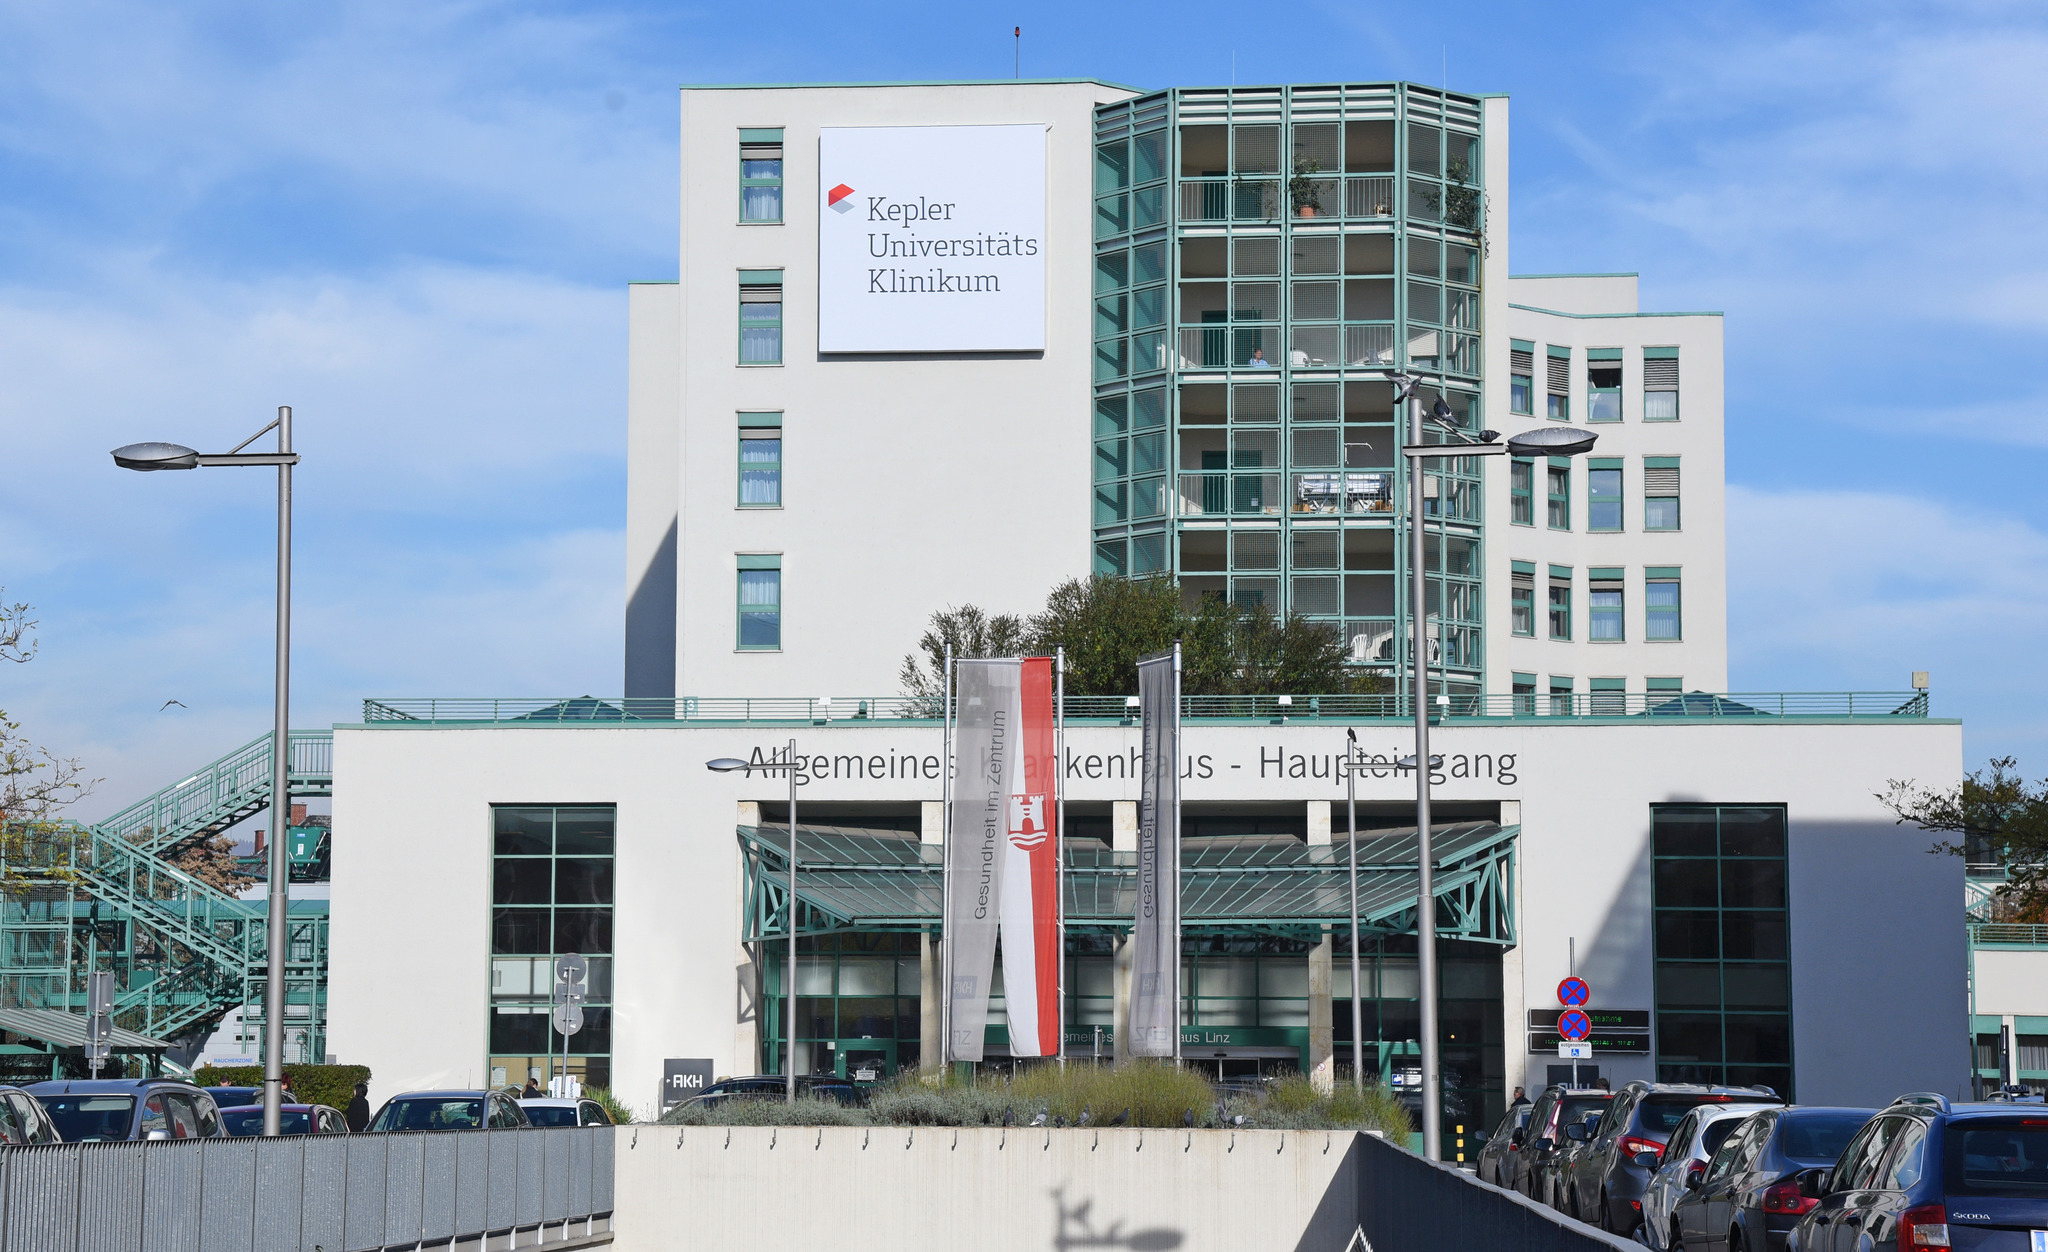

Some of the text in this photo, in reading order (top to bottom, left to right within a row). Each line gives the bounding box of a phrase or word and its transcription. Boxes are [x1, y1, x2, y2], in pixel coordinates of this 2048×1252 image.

[867, 196, 956, 229] Kepler
[867, 231, 1038, 258] Universitäts
[867, 268, 1001, 293] Klinikum
[745, 746, 960, 786] Allgemeines
[979, 746, 1214, 780] Kankenhaus
[974, 710, 1006, 920] Gesundheit im Zentrum
[1205, 1031, 1231, 1044] Linz
[672, 1074, 703, 1089] AKH
